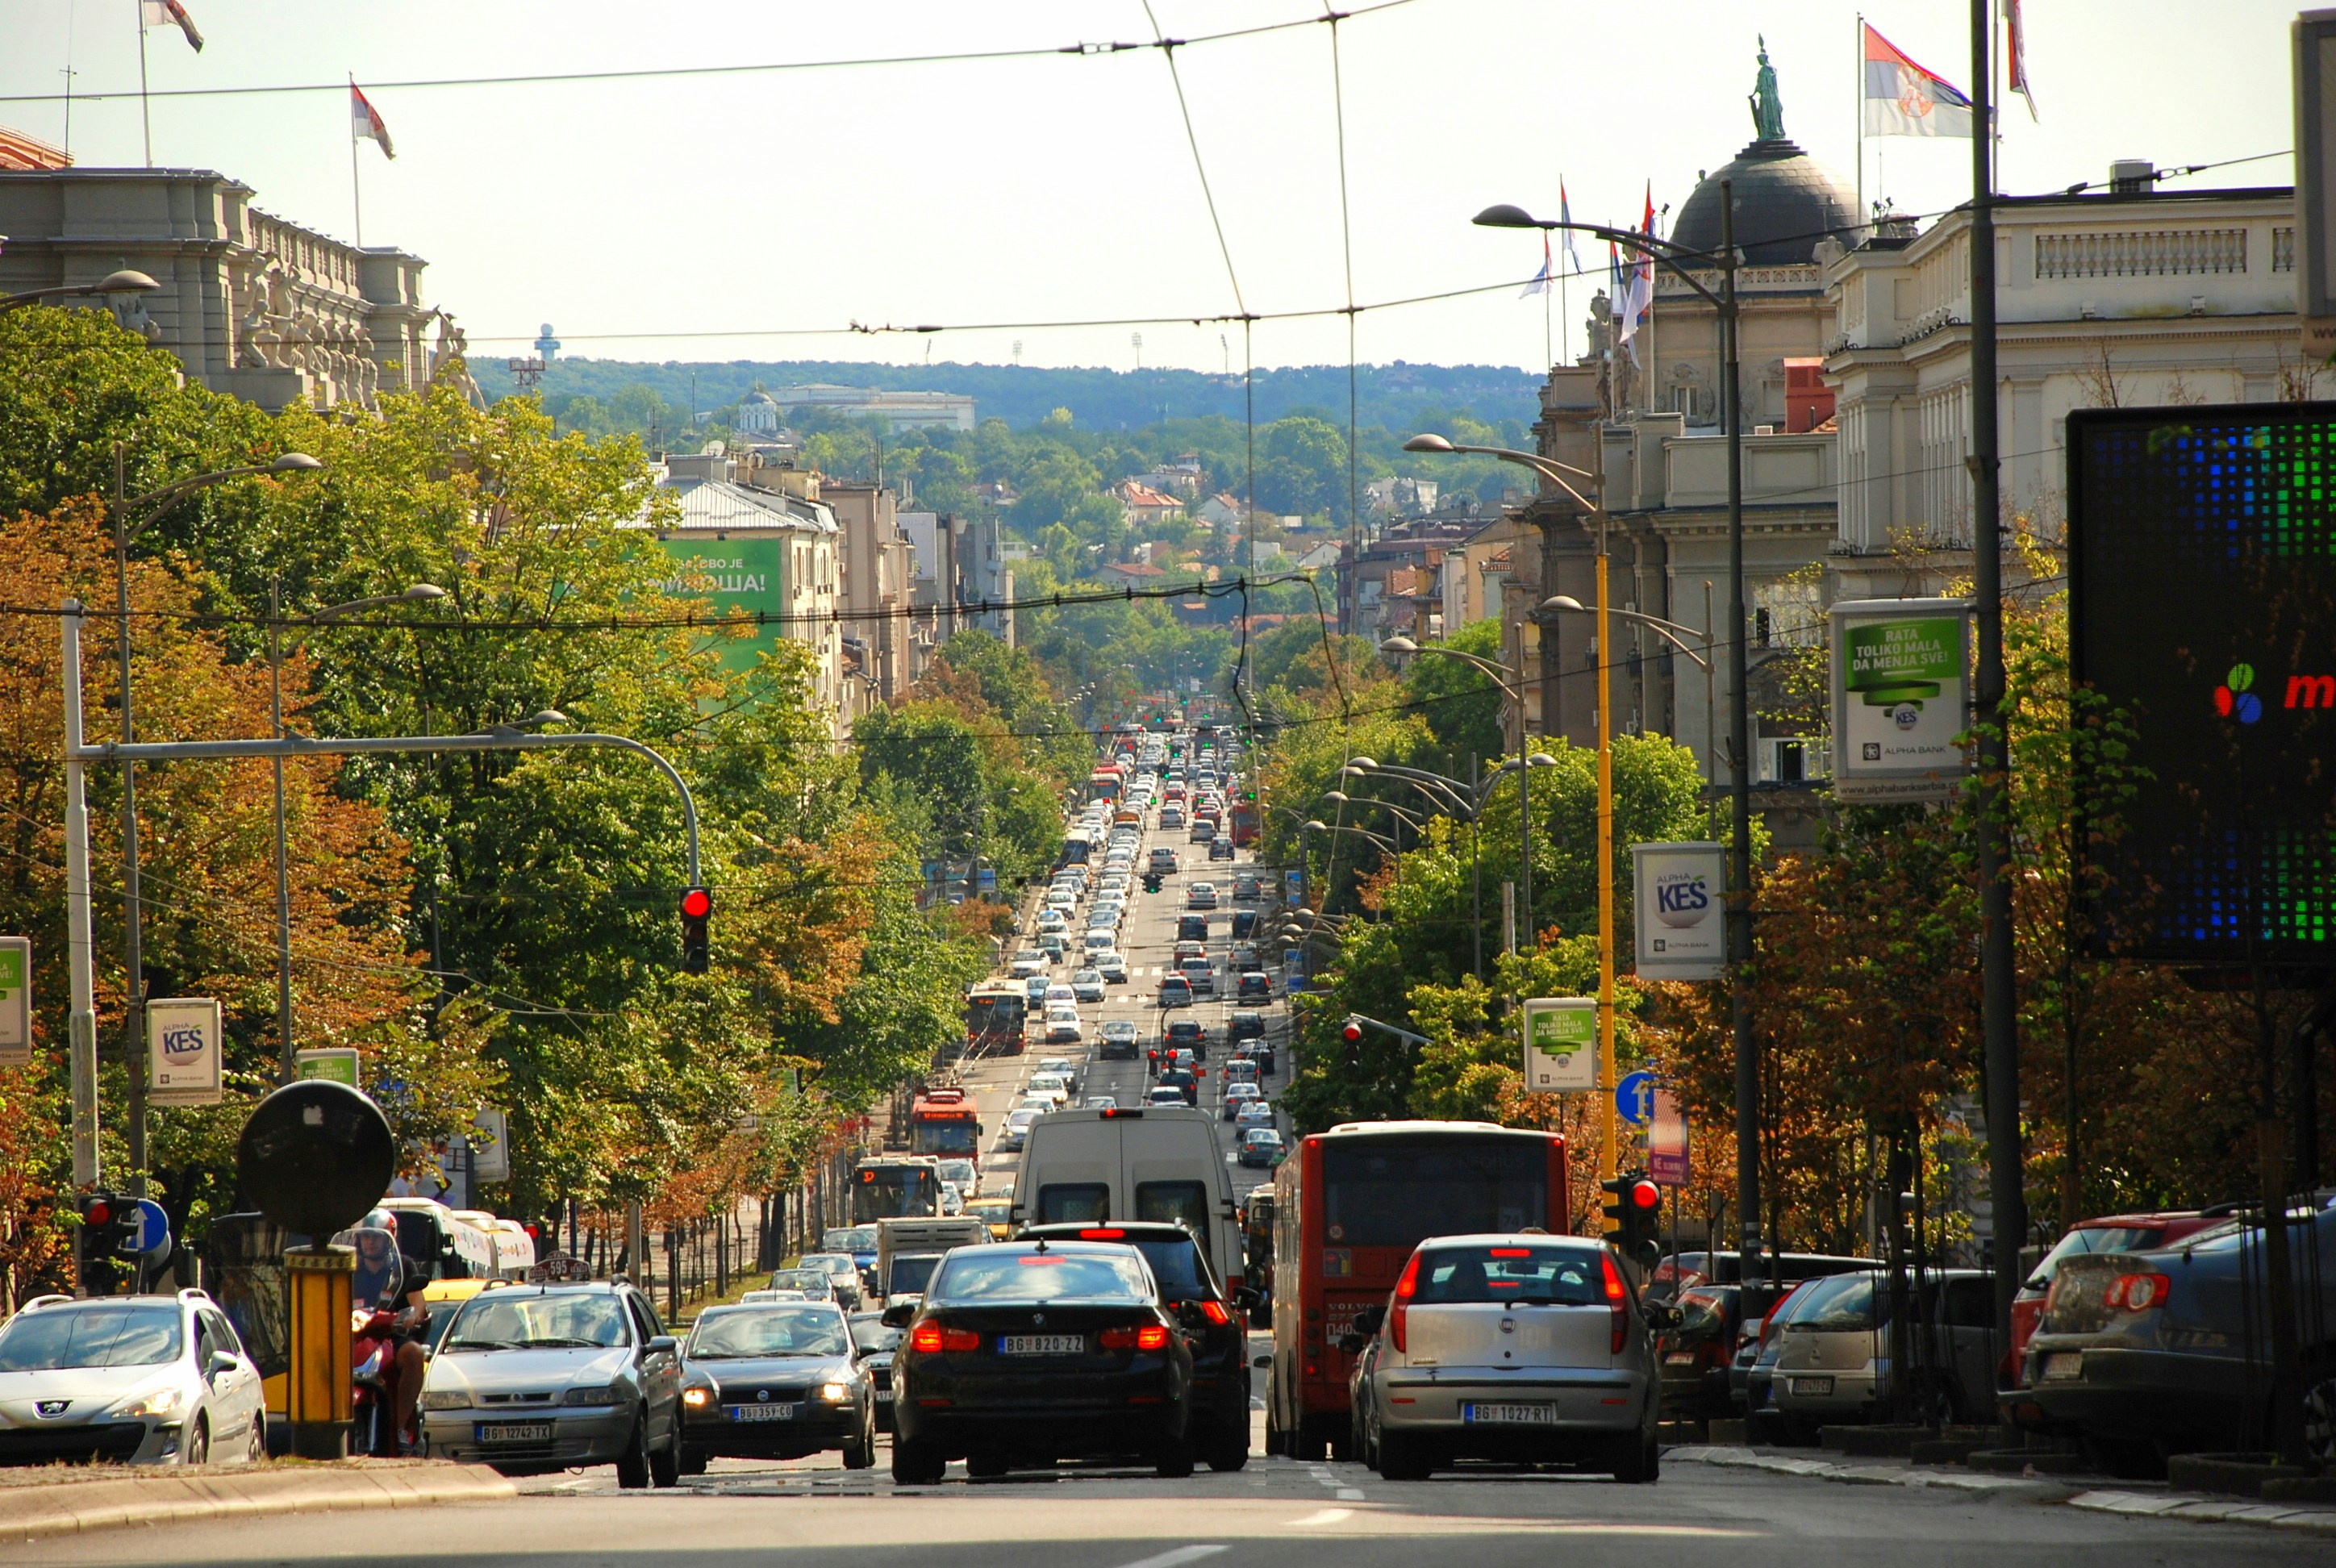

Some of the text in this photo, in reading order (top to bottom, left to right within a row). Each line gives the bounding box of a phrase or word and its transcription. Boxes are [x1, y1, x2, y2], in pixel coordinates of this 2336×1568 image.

[1885, 628, 1918, 642] RATA
[1855, 639, 1942, 658] TOLIKO MALA
[1852, 650, 1948, 671] DA MENJA SVE!
[1884, 746, 1946, 755] ALPHA BANK
[1656, 873, 1692, 884] ALPHA
[162, 1022, 190, 1032] ALPHA
[1546, 1028, 1570, 1036] MENJA
[550, 1260, 567, 1274] 595
[1007, 1338, 1024, 1352] BG
[740, 1408, 752, 1419] BG
[1475, 1406, 1490, 1420] BG
[484, 1428, 498, 1440] BG
